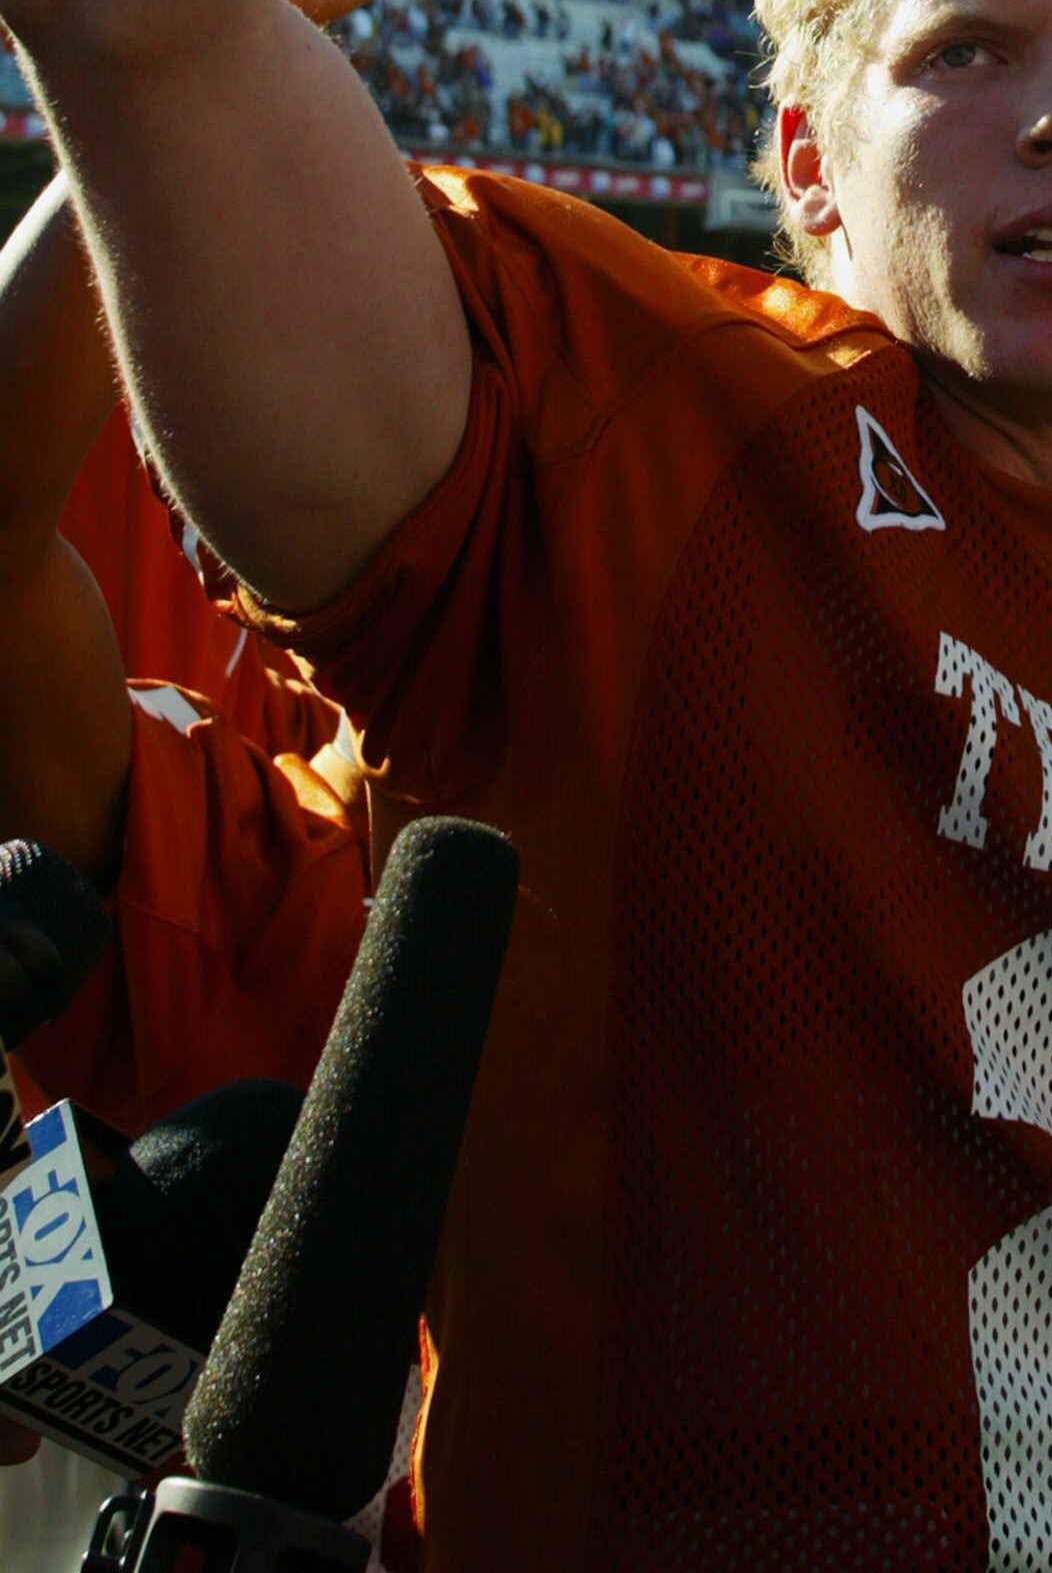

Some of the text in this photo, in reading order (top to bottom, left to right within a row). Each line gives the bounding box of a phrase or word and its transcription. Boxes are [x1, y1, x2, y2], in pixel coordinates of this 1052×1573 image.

[12, 1139, 98, 1324] FOX
[9, 1361, 179, 1458] SPORTS NET
